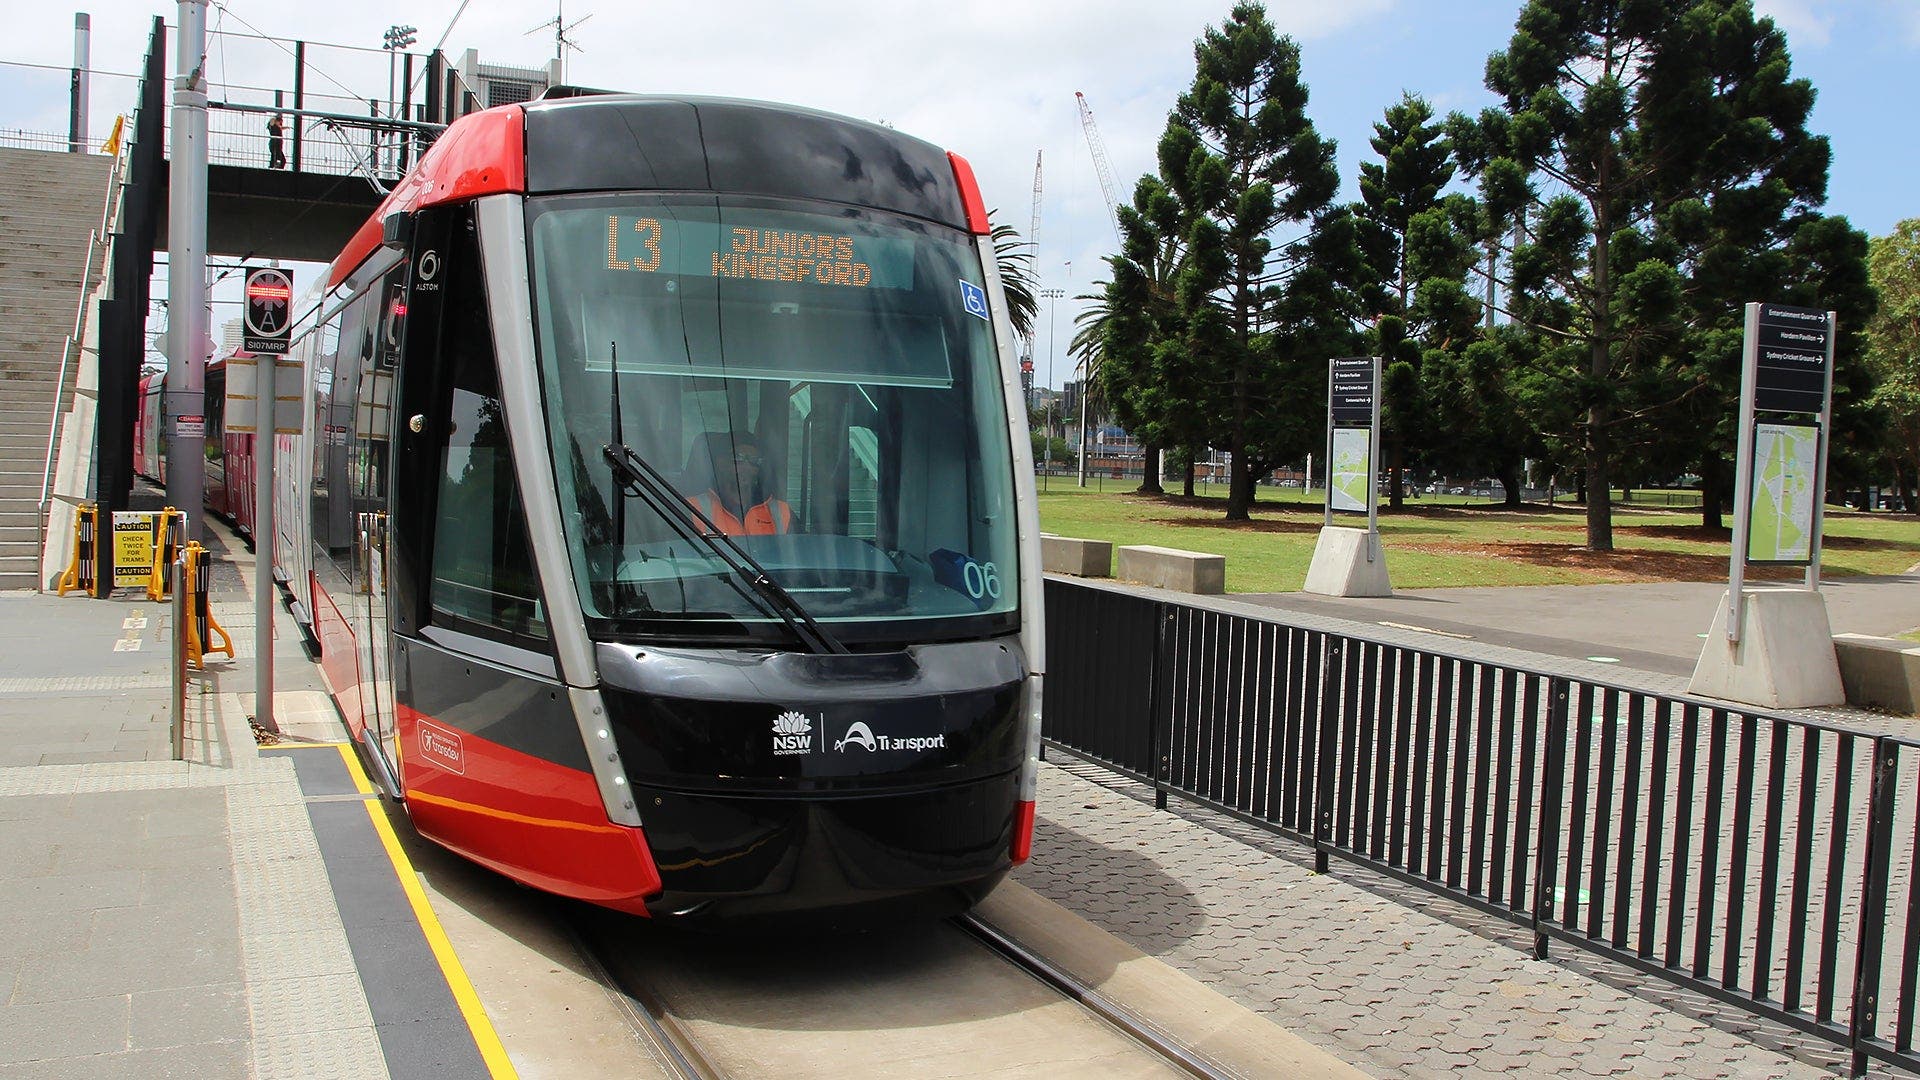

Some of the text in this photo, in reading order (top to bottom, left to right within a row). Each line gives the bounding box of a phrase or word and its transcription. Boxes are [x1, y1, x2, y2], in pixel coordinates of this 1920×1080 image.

[607, 215, 663, 273] L3
[731, 226, 854, 260] JUNIORS
[711, 251, 871, 287] KINGSFORD
[415, 283, 439, 291] ALSTOM
[963, 561, 1002, 599] 06
[773, 735, 812, 750] NSW
[773, 748, 811, 756] GOVERNMENT
